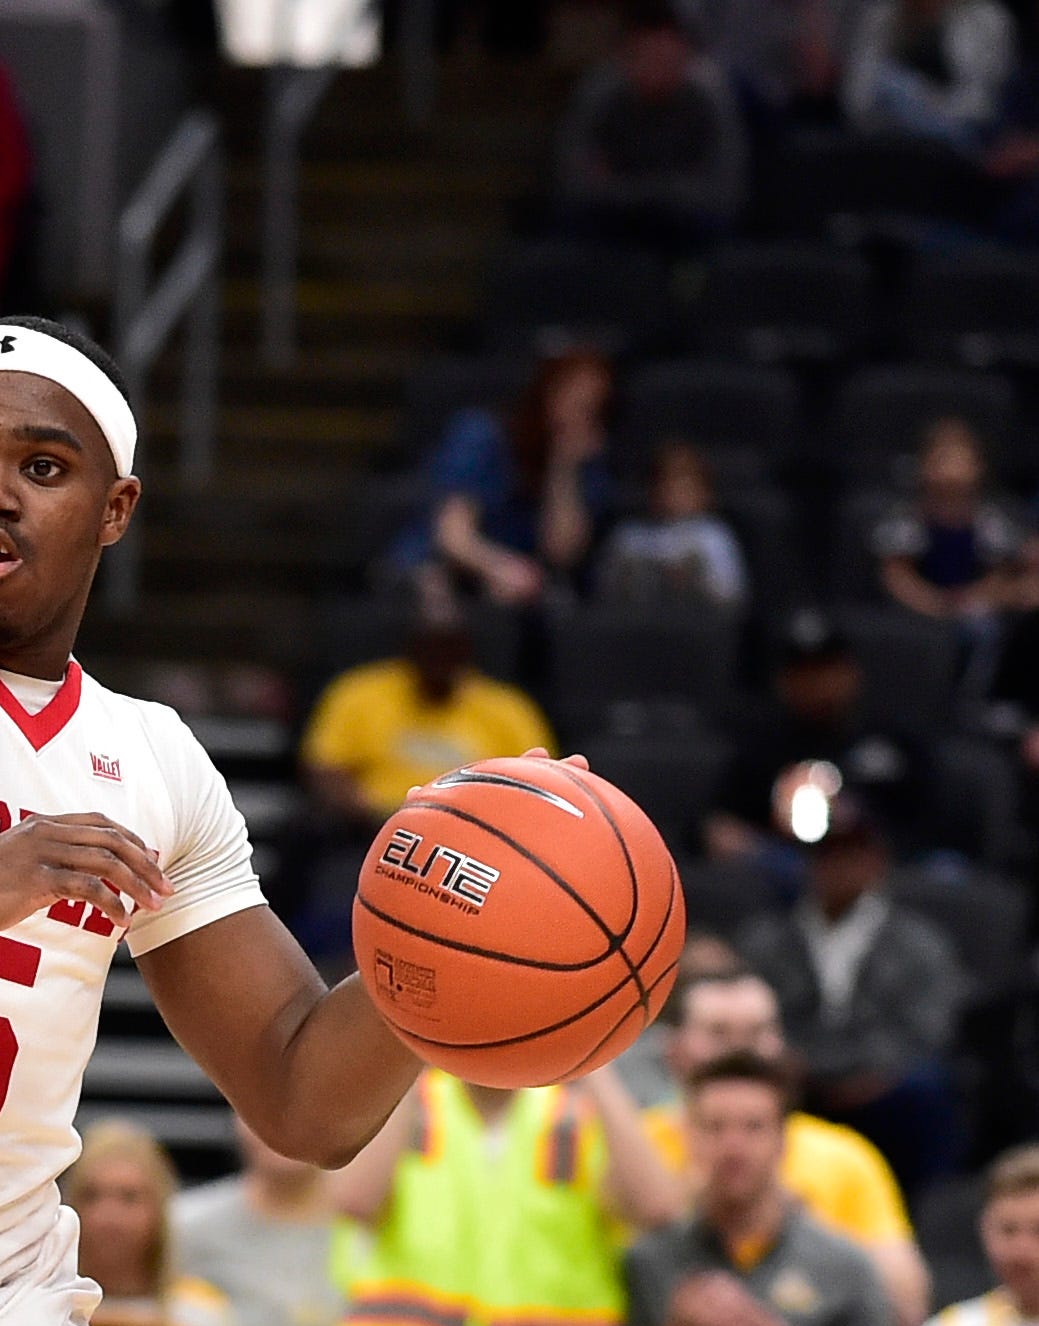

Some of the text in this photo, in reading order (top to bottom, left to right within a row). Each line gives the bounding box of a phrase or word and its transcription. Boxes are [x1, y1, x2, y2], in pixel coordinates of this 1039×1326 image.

[89, 751, 121, 778] VALLEY
[374, 865, 480, 916] CHAMPIONSHIP
[380, 828, 500, 907] ELITE
